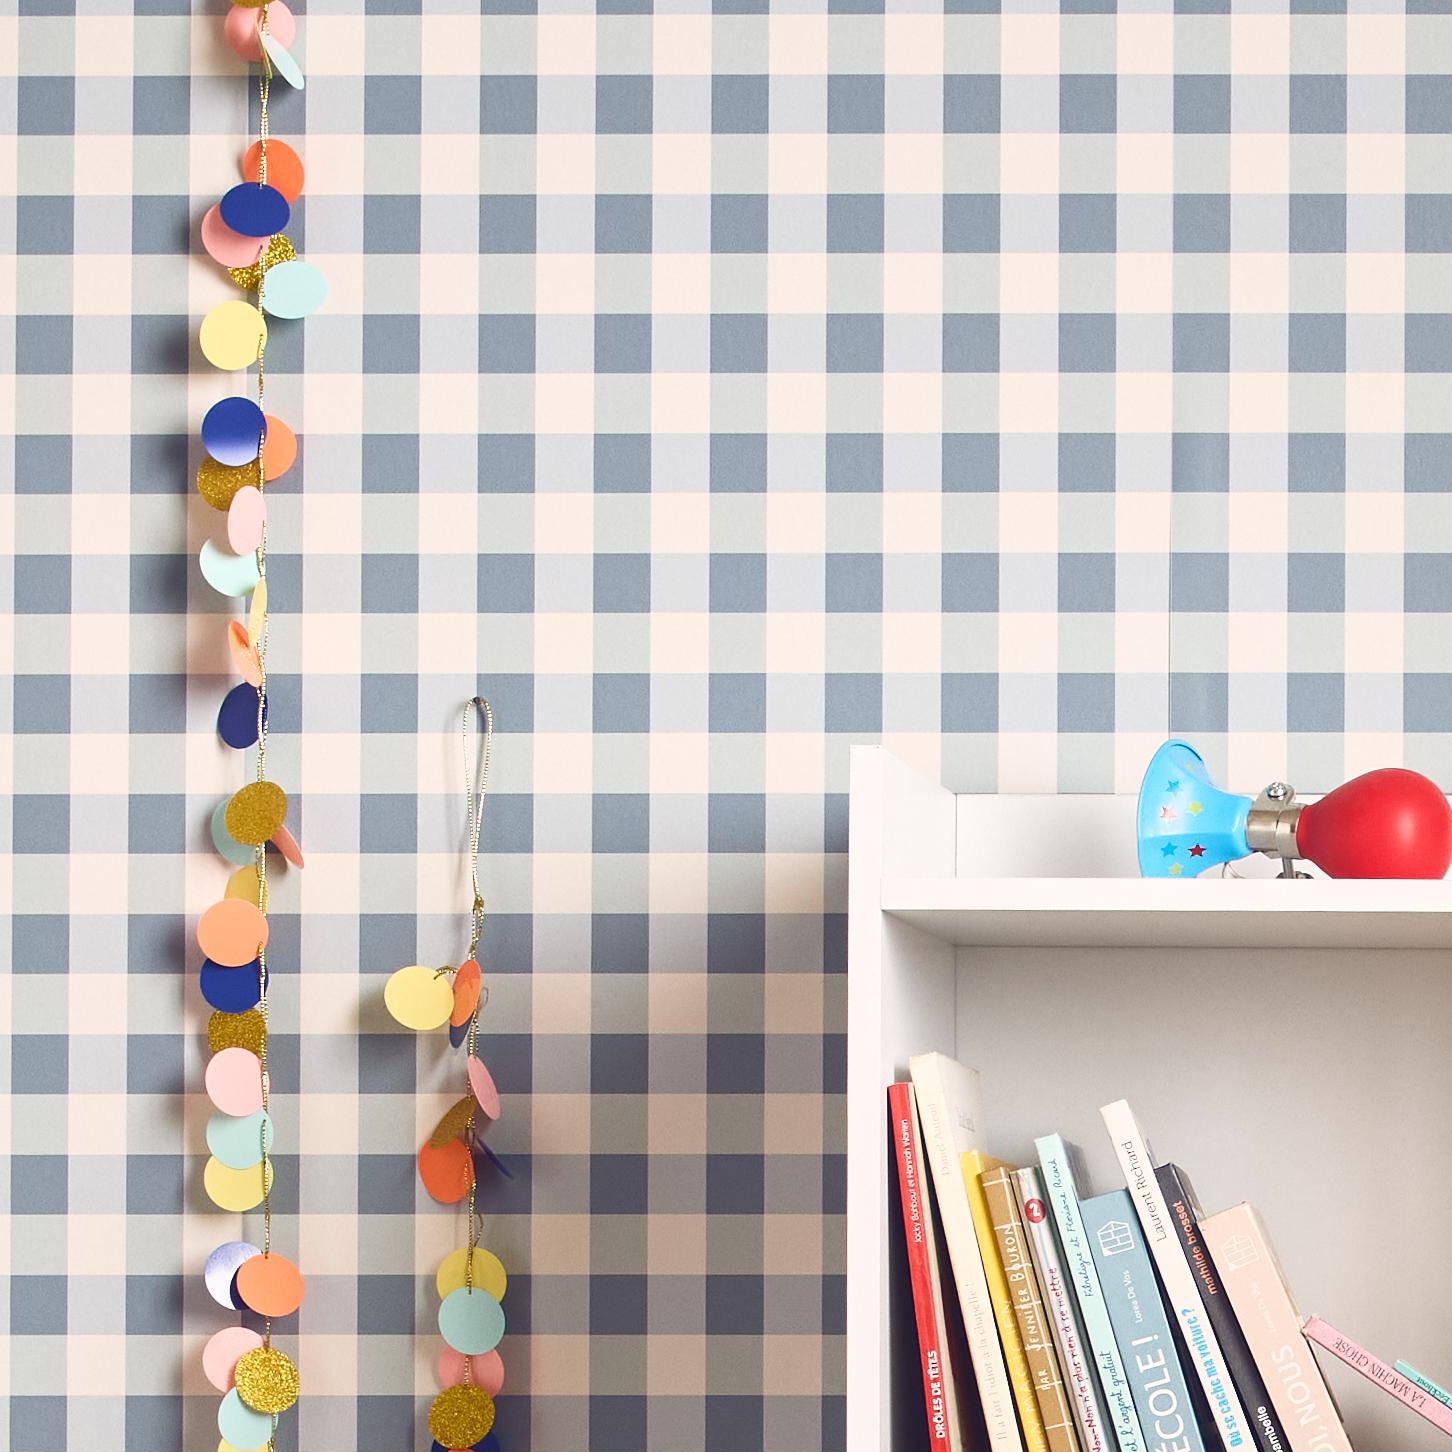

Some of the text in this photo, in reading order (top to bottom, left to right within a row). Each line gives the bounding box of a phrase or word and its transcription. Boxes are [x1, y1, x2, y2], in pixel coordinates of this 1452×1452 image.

[907, 1178, 915, 1187] et
[1120, 1140, 1167, 1241] Laurent Richard
[1029, 1202, 1041, 1218] 2
[1068, 1236, 1080, 1249] et
[1171, 1199, 1218, 1295] mathilde brosset
[1065, 1336, 1078, 1358] rien
[1183, 1315, 1211, 1359] voiture
[1070, 1360, 1087, 1382] plus
[1098, 1349, 1124, 1388] gratuit
[1202, 1359, 1218, 1378] ma
[1331, 1336, 1427, 1408] LA MACHIN CHOSE
[924, 1350, 947, 1438] DRÔLES DE TÊTES
[1206, 1376, 1232, 1415] cache
[1269, 1343, 1321, 1427] NOUS
[1109, 1388, 1137, 1436] l'argent
[1222, 1414, 1237, 1430] se
[1125, 1439, 1138, 1452] et
[1226, 1429, 1244, 1448] Où
